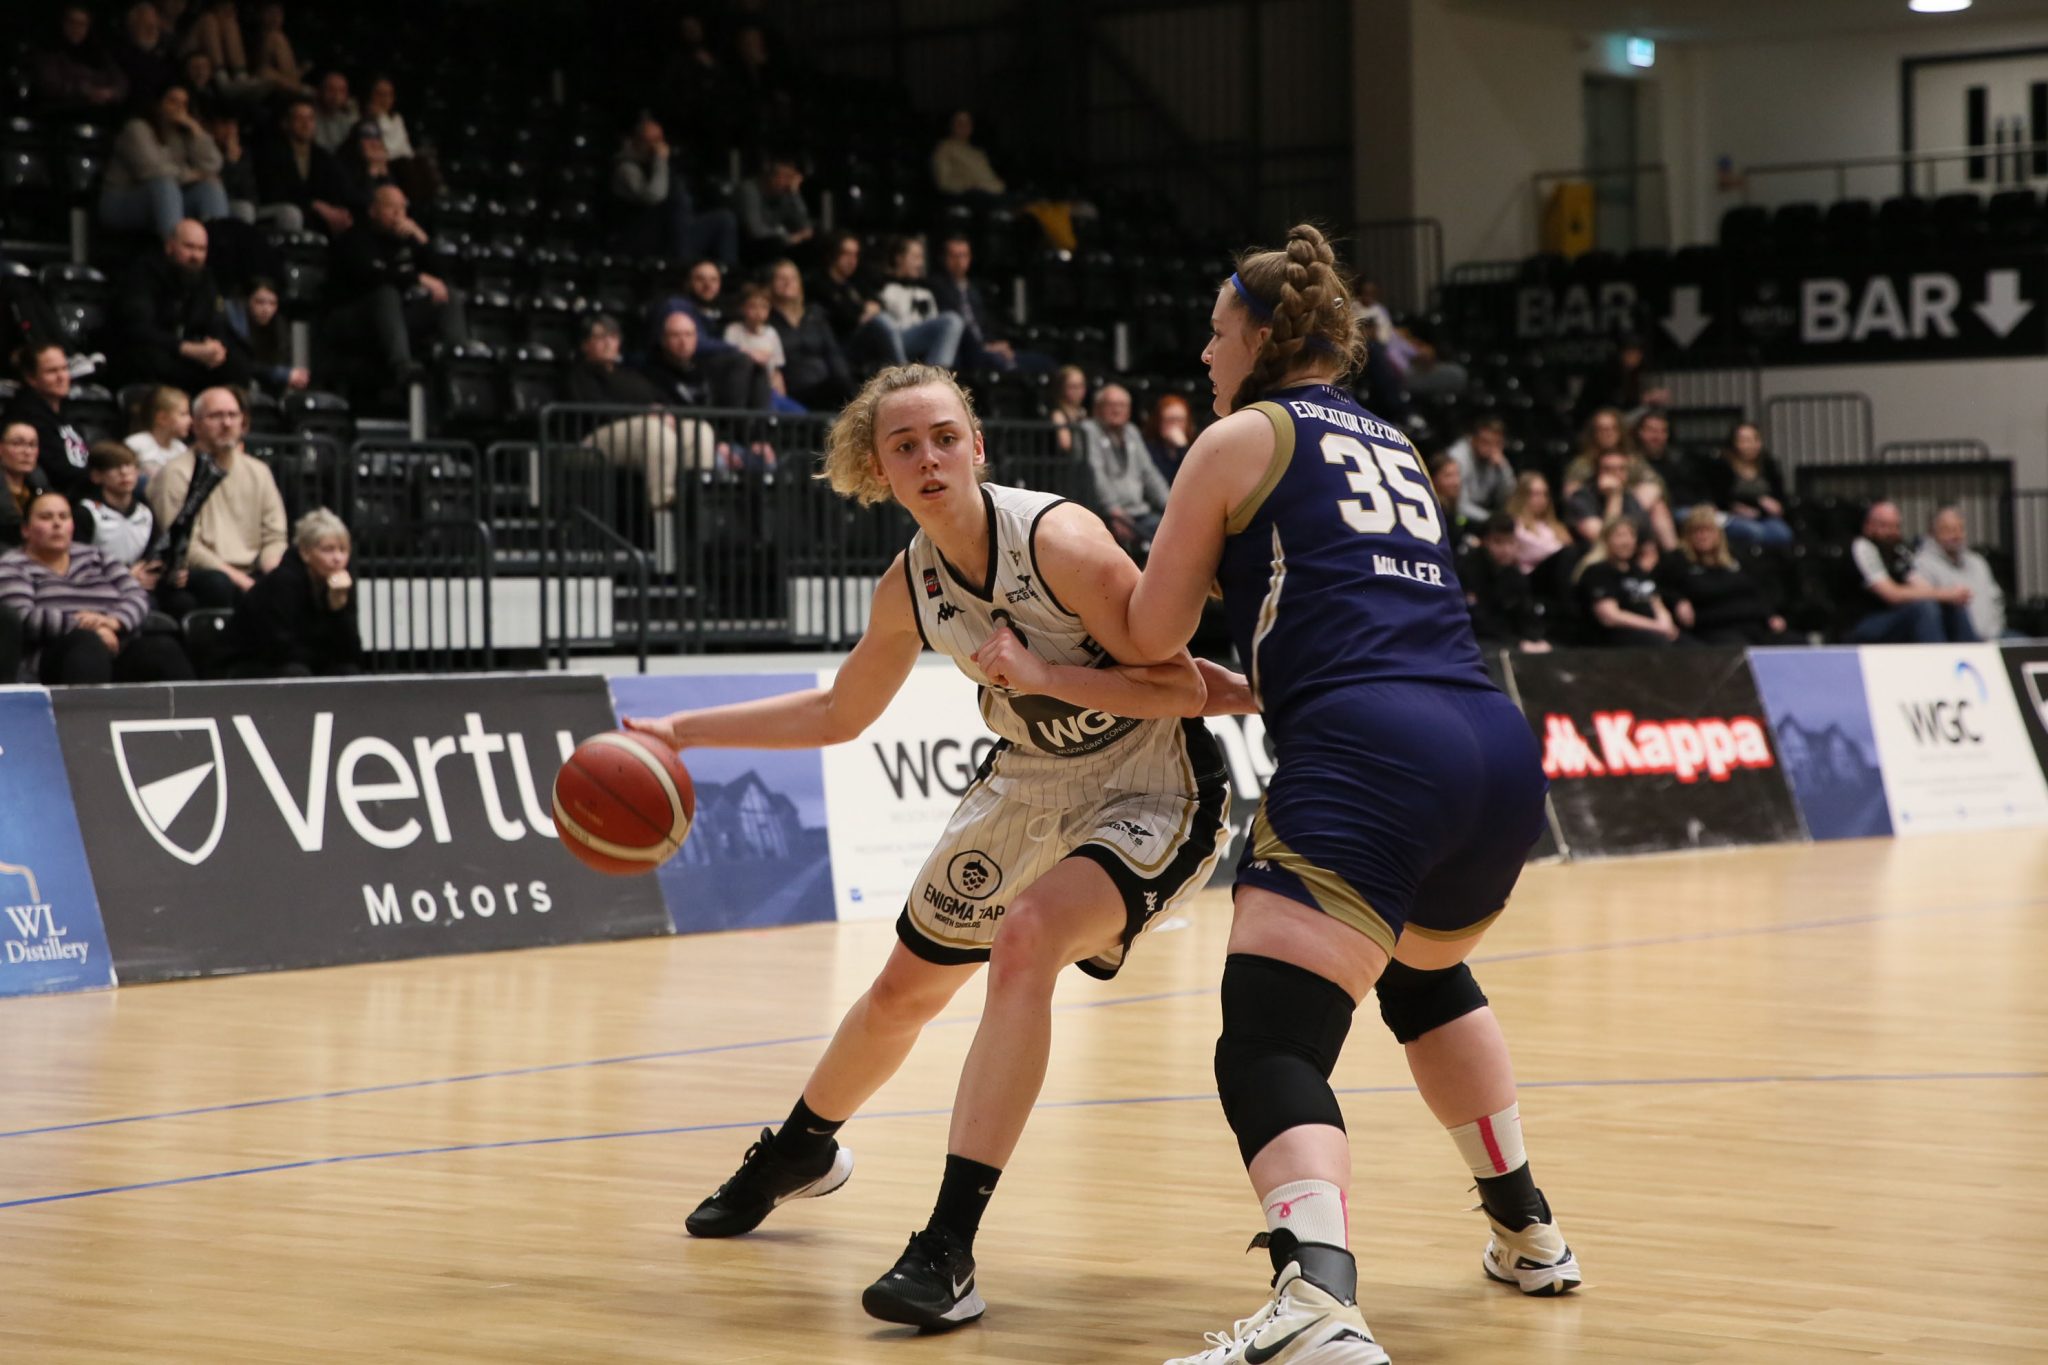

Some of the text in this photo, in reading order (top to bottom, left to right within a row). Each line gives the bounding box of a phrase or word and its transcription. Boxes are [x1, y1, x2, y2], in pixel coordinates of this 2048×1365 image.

[1517, 283, 1638, 337] BAR
[1803, 273, 1960, 342] BAR
[1289, 401, 1362, 434] EDUCATION
[1319, 432, 1442, 545] 35
[1372, 554, 1447, 587] MILLER
[1036, 708, 1121, 748] WG
[1084, 738, 1104, 751] GRAY
[1103, 718, 1137, 740] CONSUL
[1899, 699, 1983, 745] WGC
[1595, 712, 1773, 781] Kappa
[232, 712, 574, 852] Vertu
[5, 903, 68, 939] WL
[363, 879, 552, 926] Motors
[923, 882, 975, 921] ENIGMA
[934, 912, 955, 927] NORTH
[5, 937, 88, 964] Distillery
